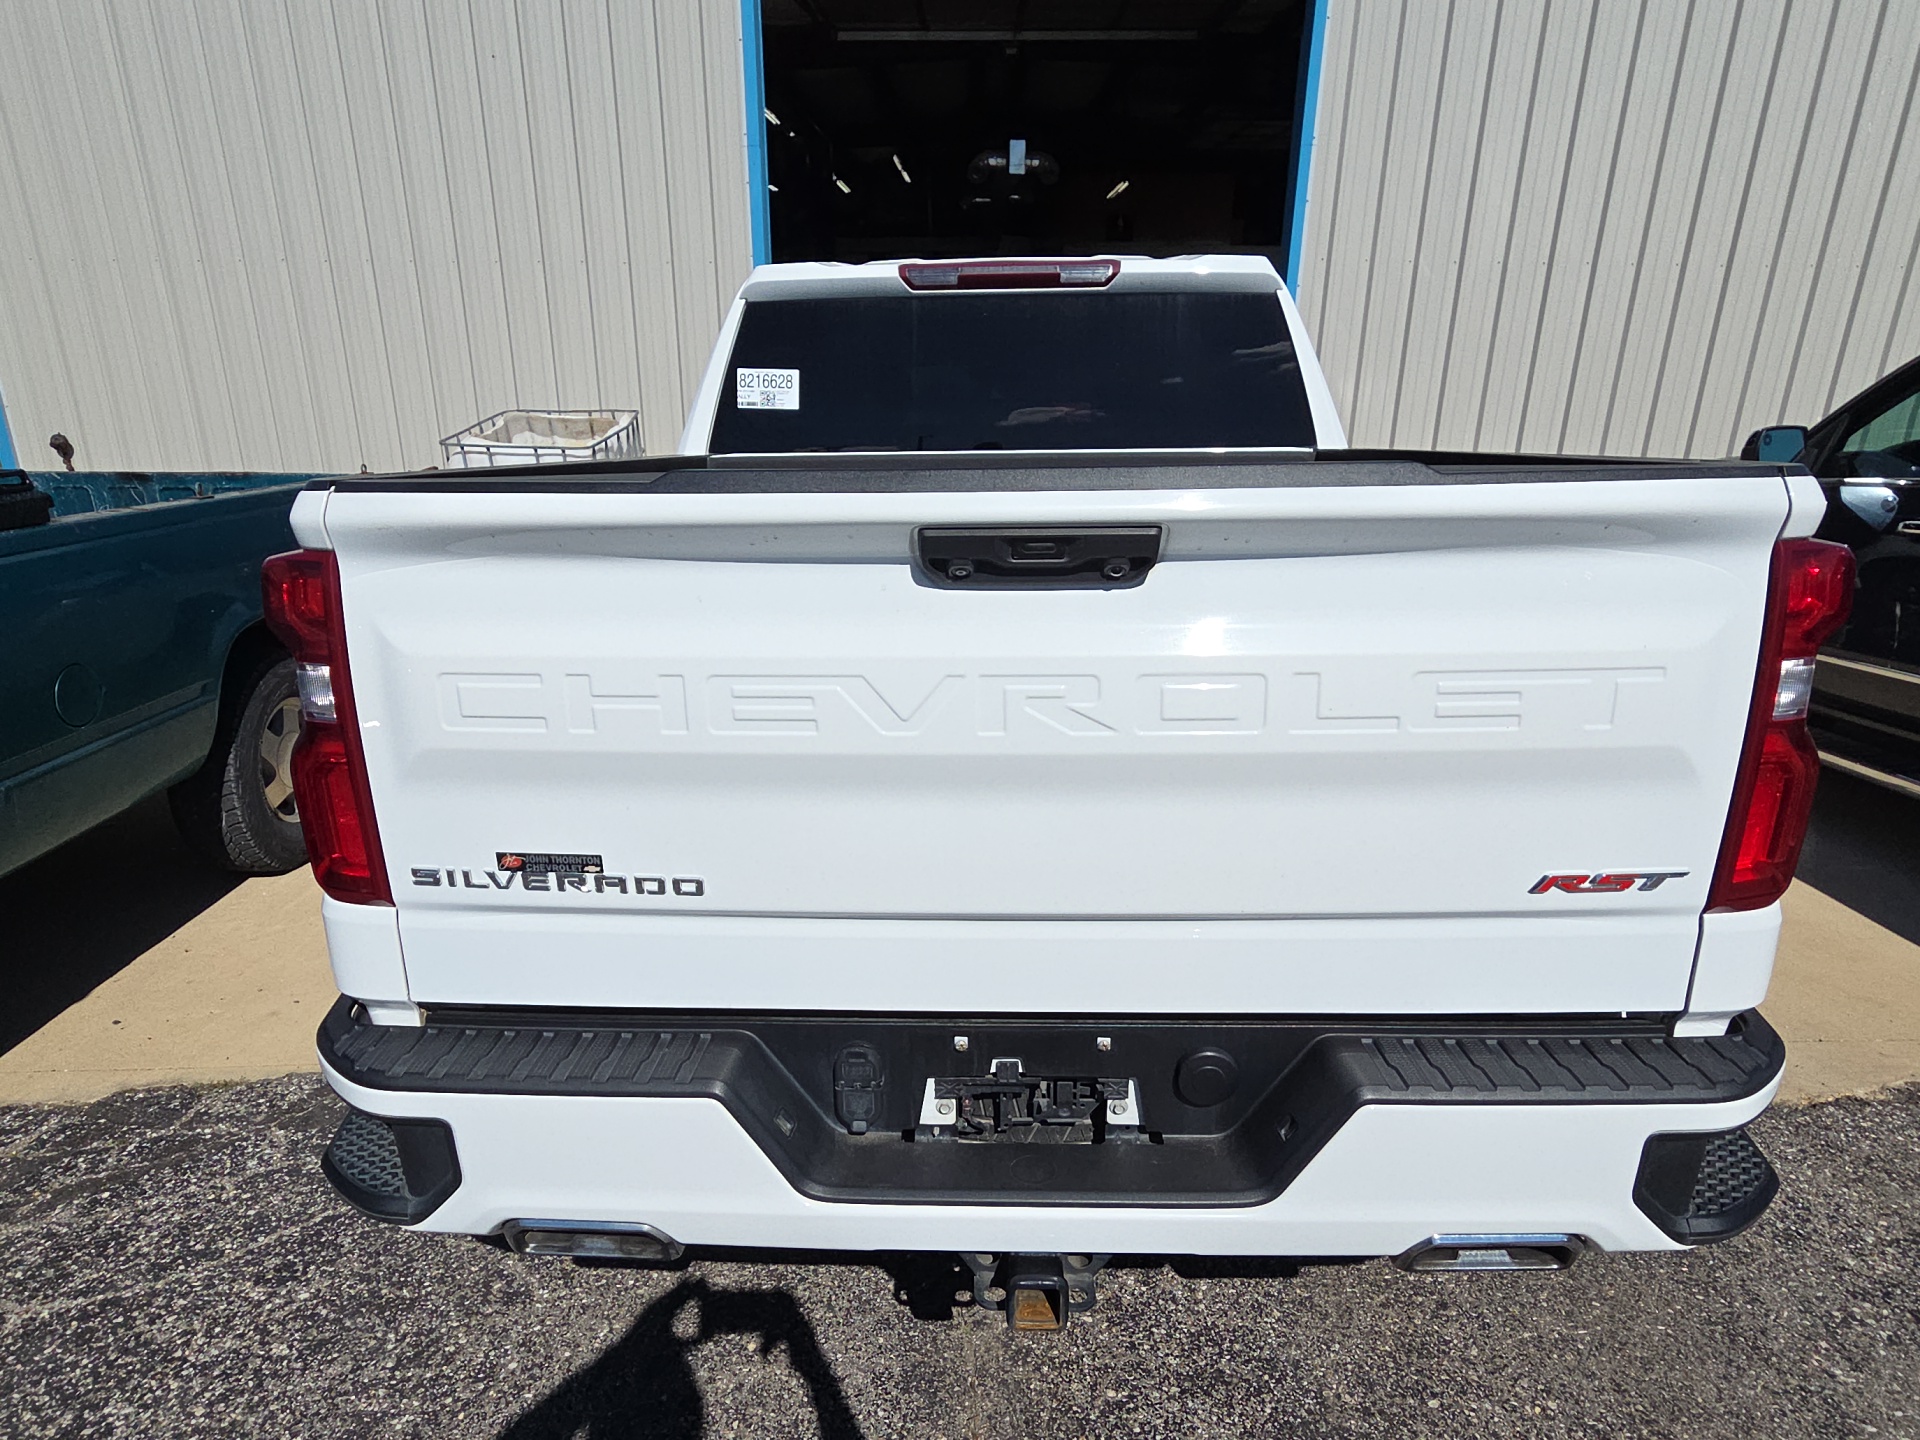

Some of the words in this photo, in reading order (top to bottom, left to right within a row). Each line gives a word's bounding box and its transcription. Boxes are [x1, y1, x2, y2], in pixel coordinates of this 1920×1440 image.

[739, 373, 793, 389] 8216628
[437, 667, 1667, 736] CHEVROLET
[525, 855, 549, 864] JOHN
[550, 856, 601, 865] THORNTON
[525, 863, 583, 872] CHEVROLET
[410, 866, 706, 897] SILVERADO
[1527, 869, 1691, 895] RST
